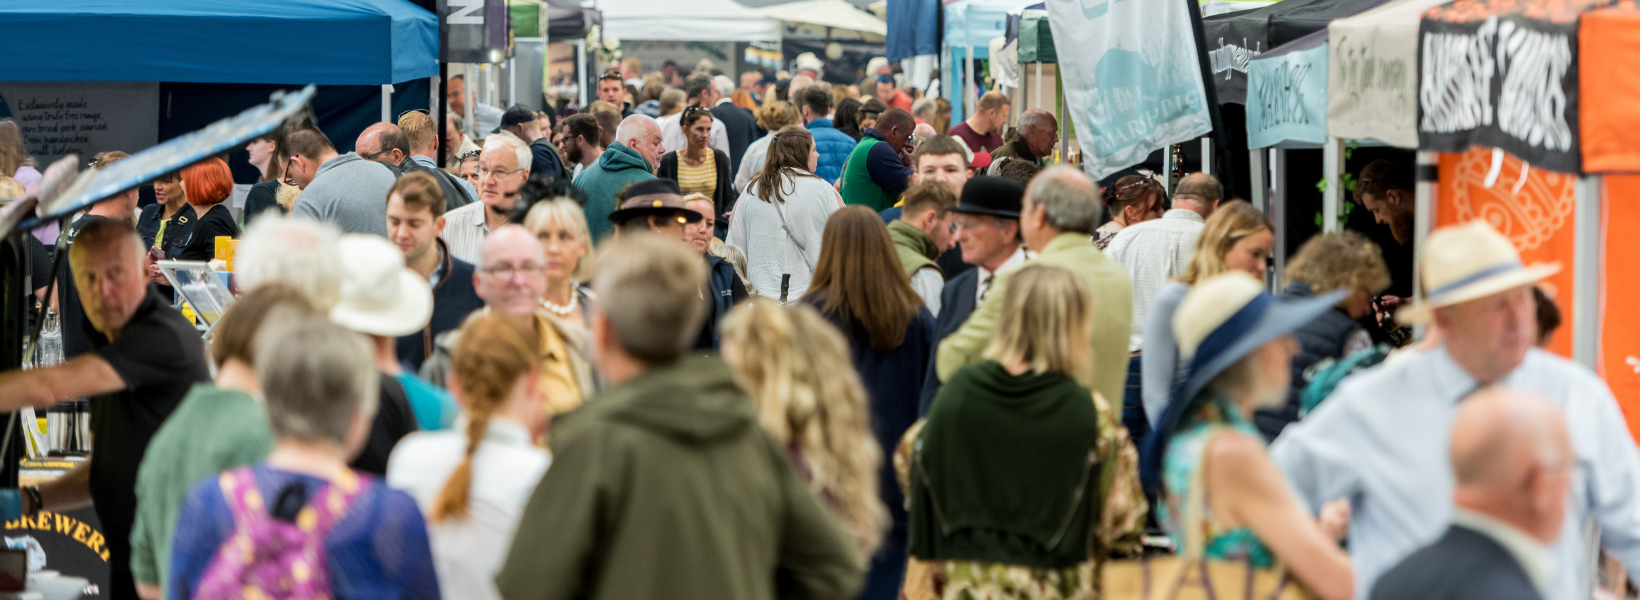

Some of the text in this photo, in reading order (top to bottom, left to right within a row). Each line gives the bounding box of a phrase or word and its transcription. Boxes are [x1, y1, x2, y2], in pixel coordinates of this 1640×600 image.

[18, 98, 88, 111] Exclusively made
[1160, 89, 1200, 118] PIG
[21, 112, 43, 123] using
[44, 110, 64, 122] truly
[65, 110, 79, 121] free
[37, 122, 58, 133] breed
[60, 122, 77, 134] pork
[79, 121, 107, 132] sourced
[44, 133, 89, 144] handpicked
